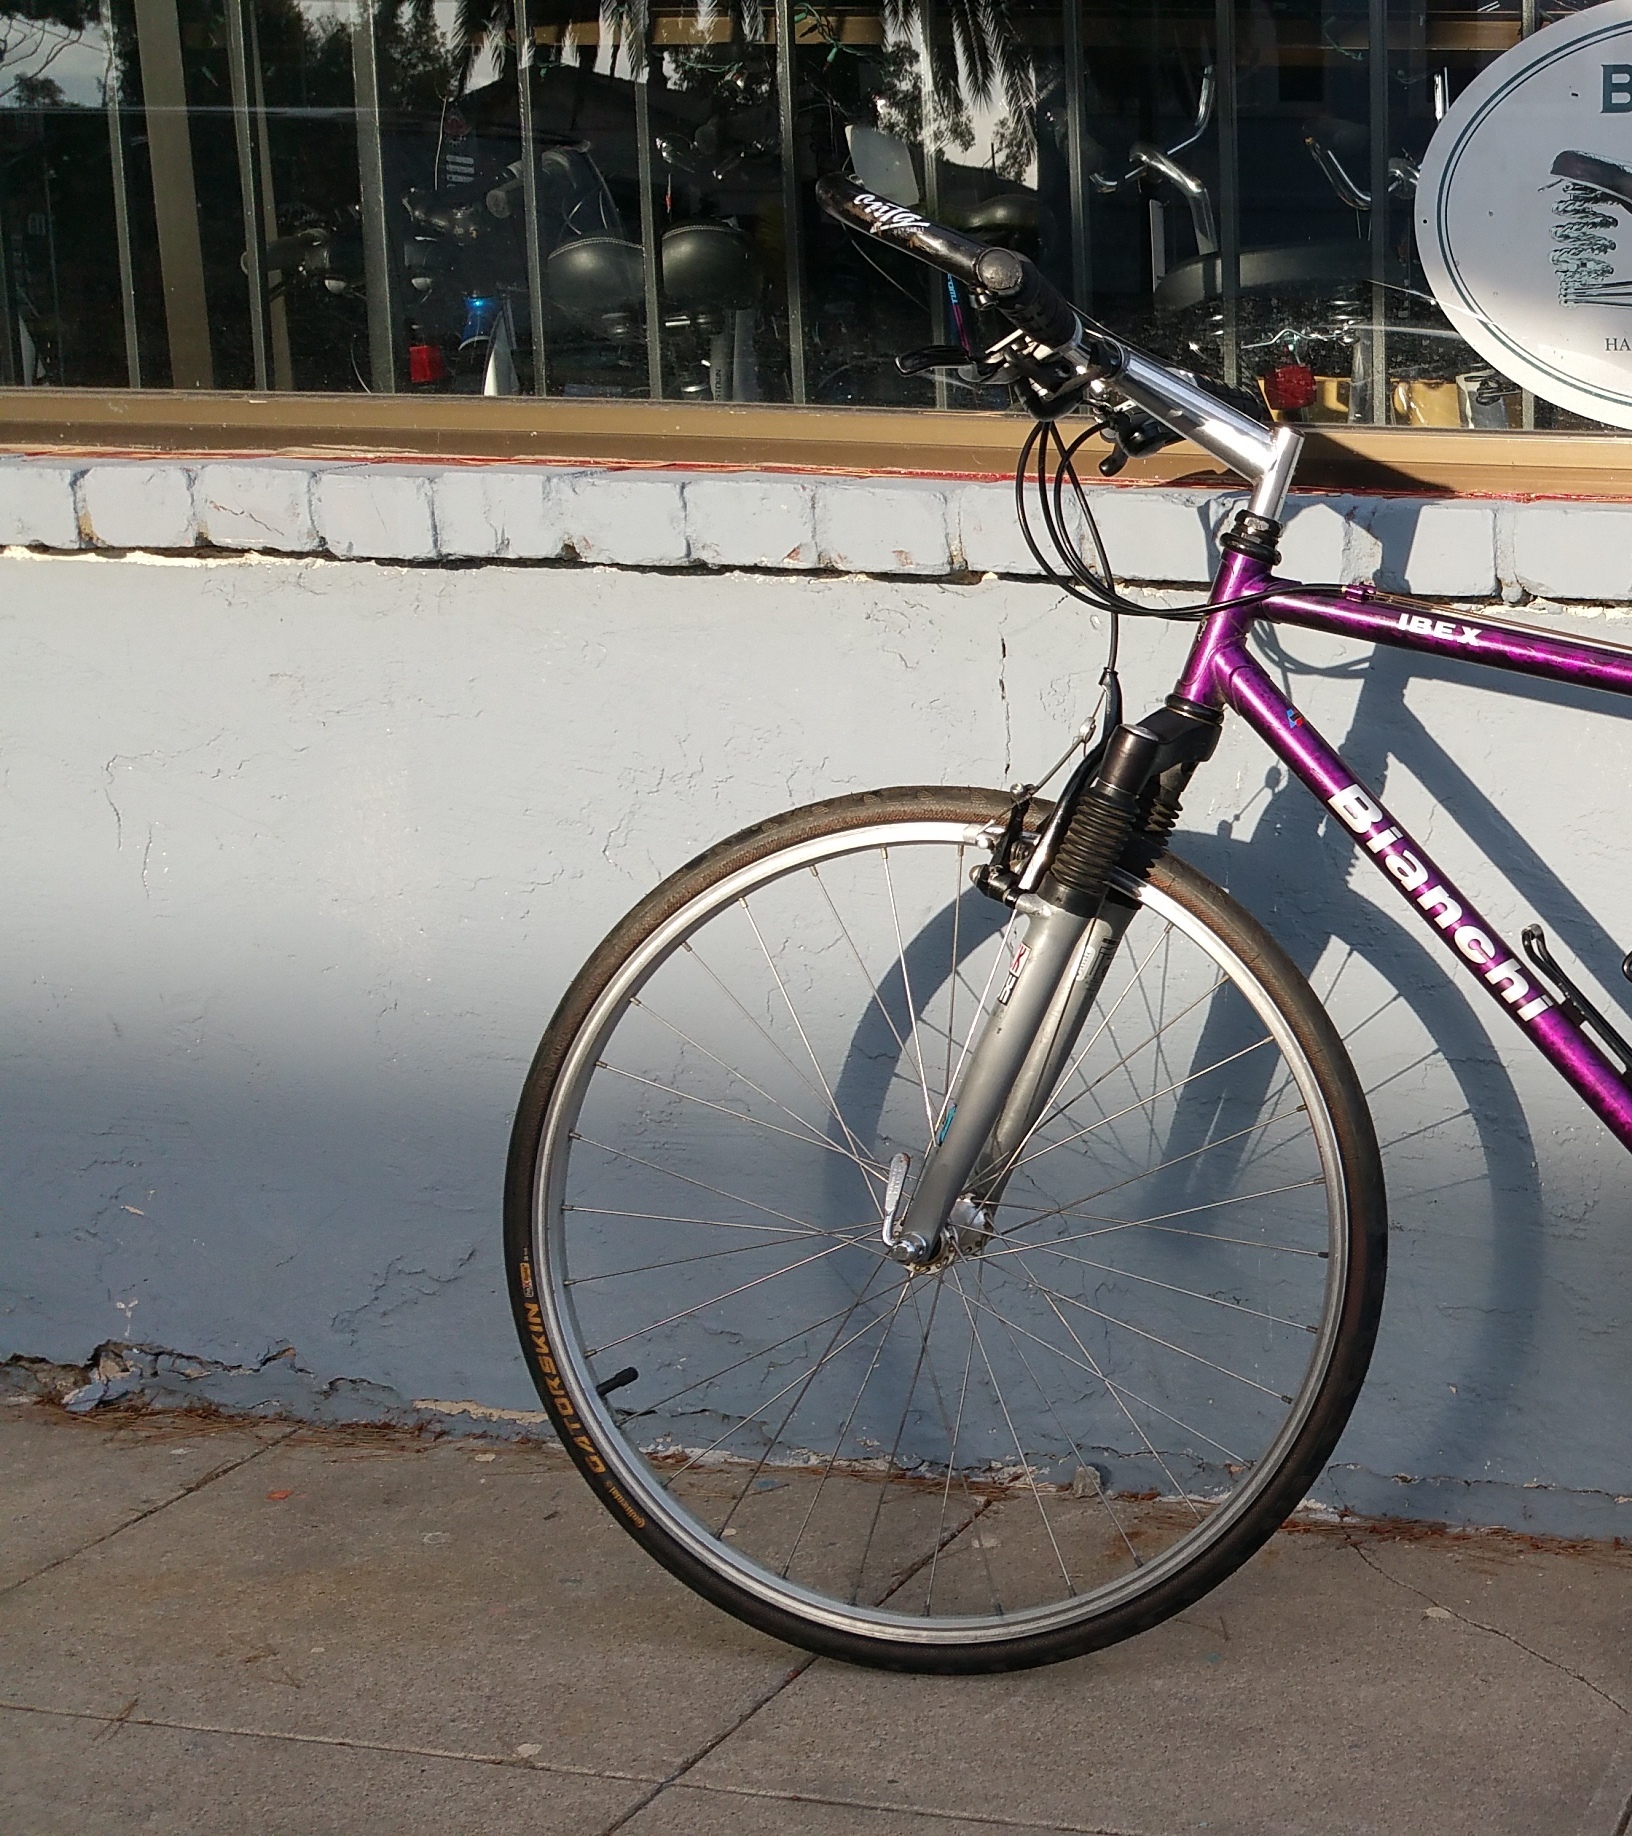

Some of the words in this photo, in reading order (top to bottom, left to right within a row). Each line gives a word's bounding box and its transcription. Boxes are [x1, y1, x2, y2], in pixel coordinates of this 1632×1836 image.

[1399, 612, 1482, 647] IBEX
[1328, 783, 1556, 1022] Bianchi
[523, 1302, 606, 1475] GATORSKIN
